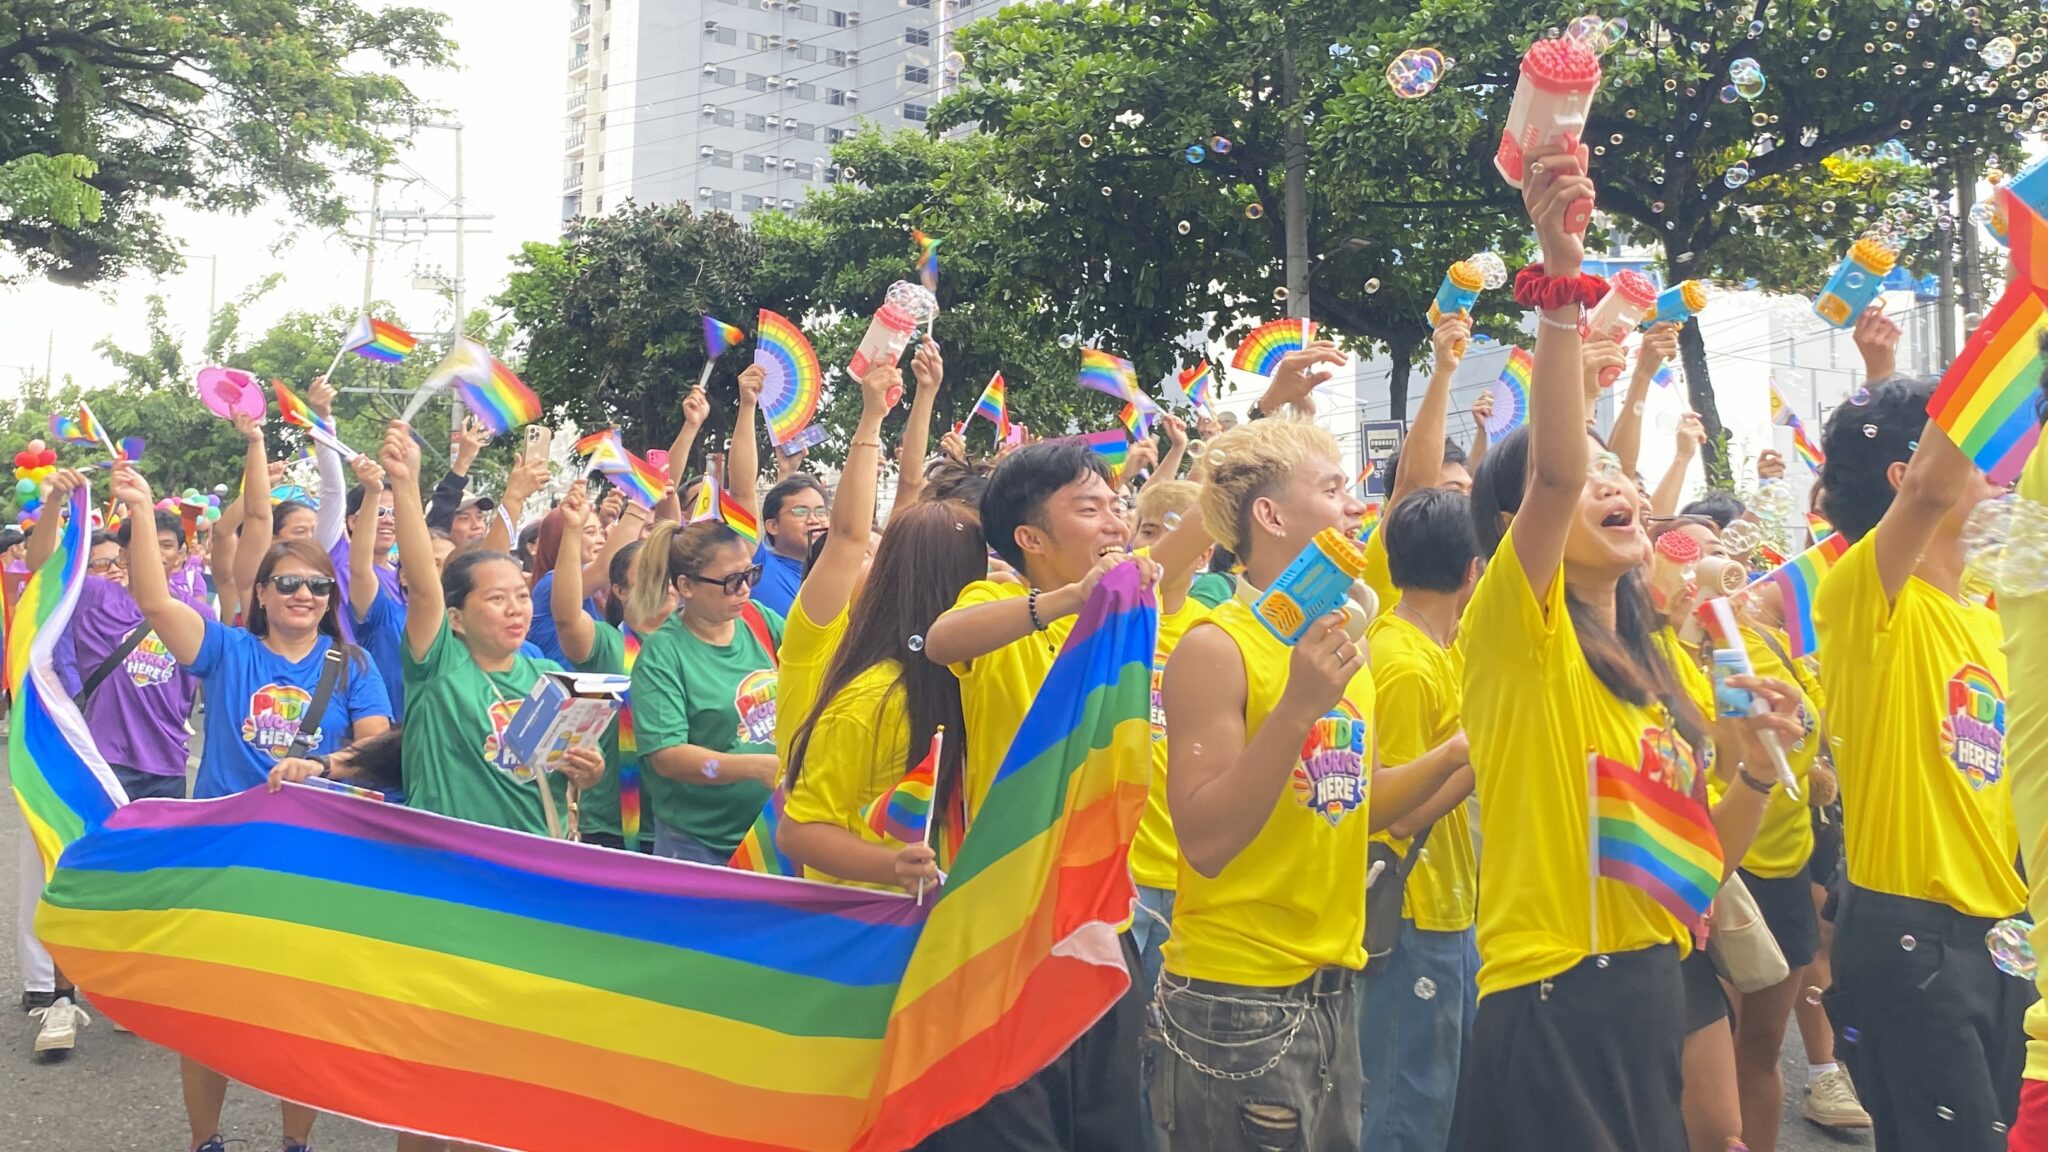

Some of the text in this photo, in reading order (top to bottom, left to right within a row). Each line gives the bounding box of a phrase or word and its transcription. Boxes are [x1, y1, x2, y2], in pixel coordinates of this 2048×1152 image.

[1373, 470, 1385, 479] ST
[127, 661, 162, 680] HERE
[1301, 719, 1365, 761] PRIDE
[1958, 739, 1998, 776] HERE
[1317, 776, 1356, 806] HERE
